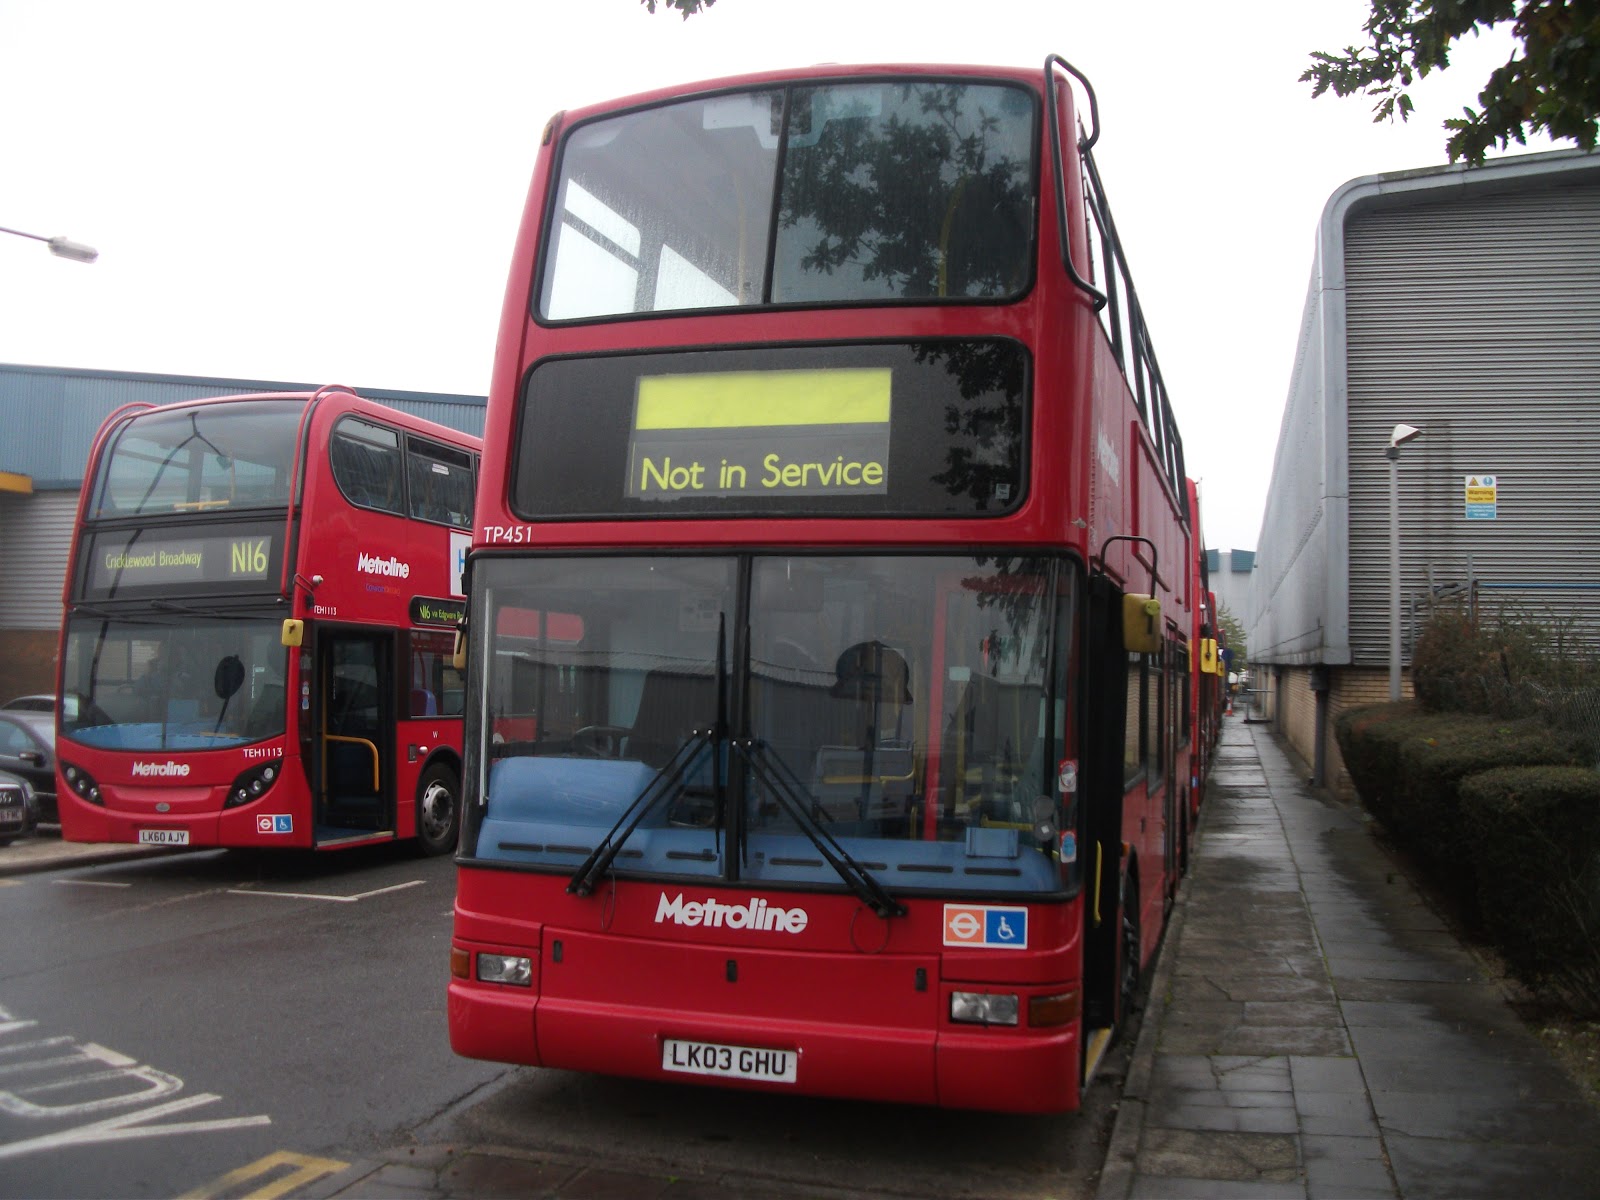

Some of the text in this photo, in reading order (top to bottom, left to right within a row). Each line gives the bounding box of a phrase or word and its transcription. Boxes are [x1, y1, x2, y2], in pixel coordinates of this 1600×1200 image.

[641, 453, 883, 491] Not in Service
[483, 526, 532, 543] TP451
[106, 550, 202, 569] Cricklewood Broadway
[232, 540, 267, 573] N16
[357, 551, 410, 579] Metroline
[314, 605, 337, 616] TEH1113
[419, 605, 431, 620] N16
[243, 747, 283, 758] TEH1113
[132, 761, 190, 776] Metroline
[142, 832, 186, 842] LK60 AJY
[654, 891, 808, 934] Metroline
[672, 1042, 787, 1076] LK03 GHU
